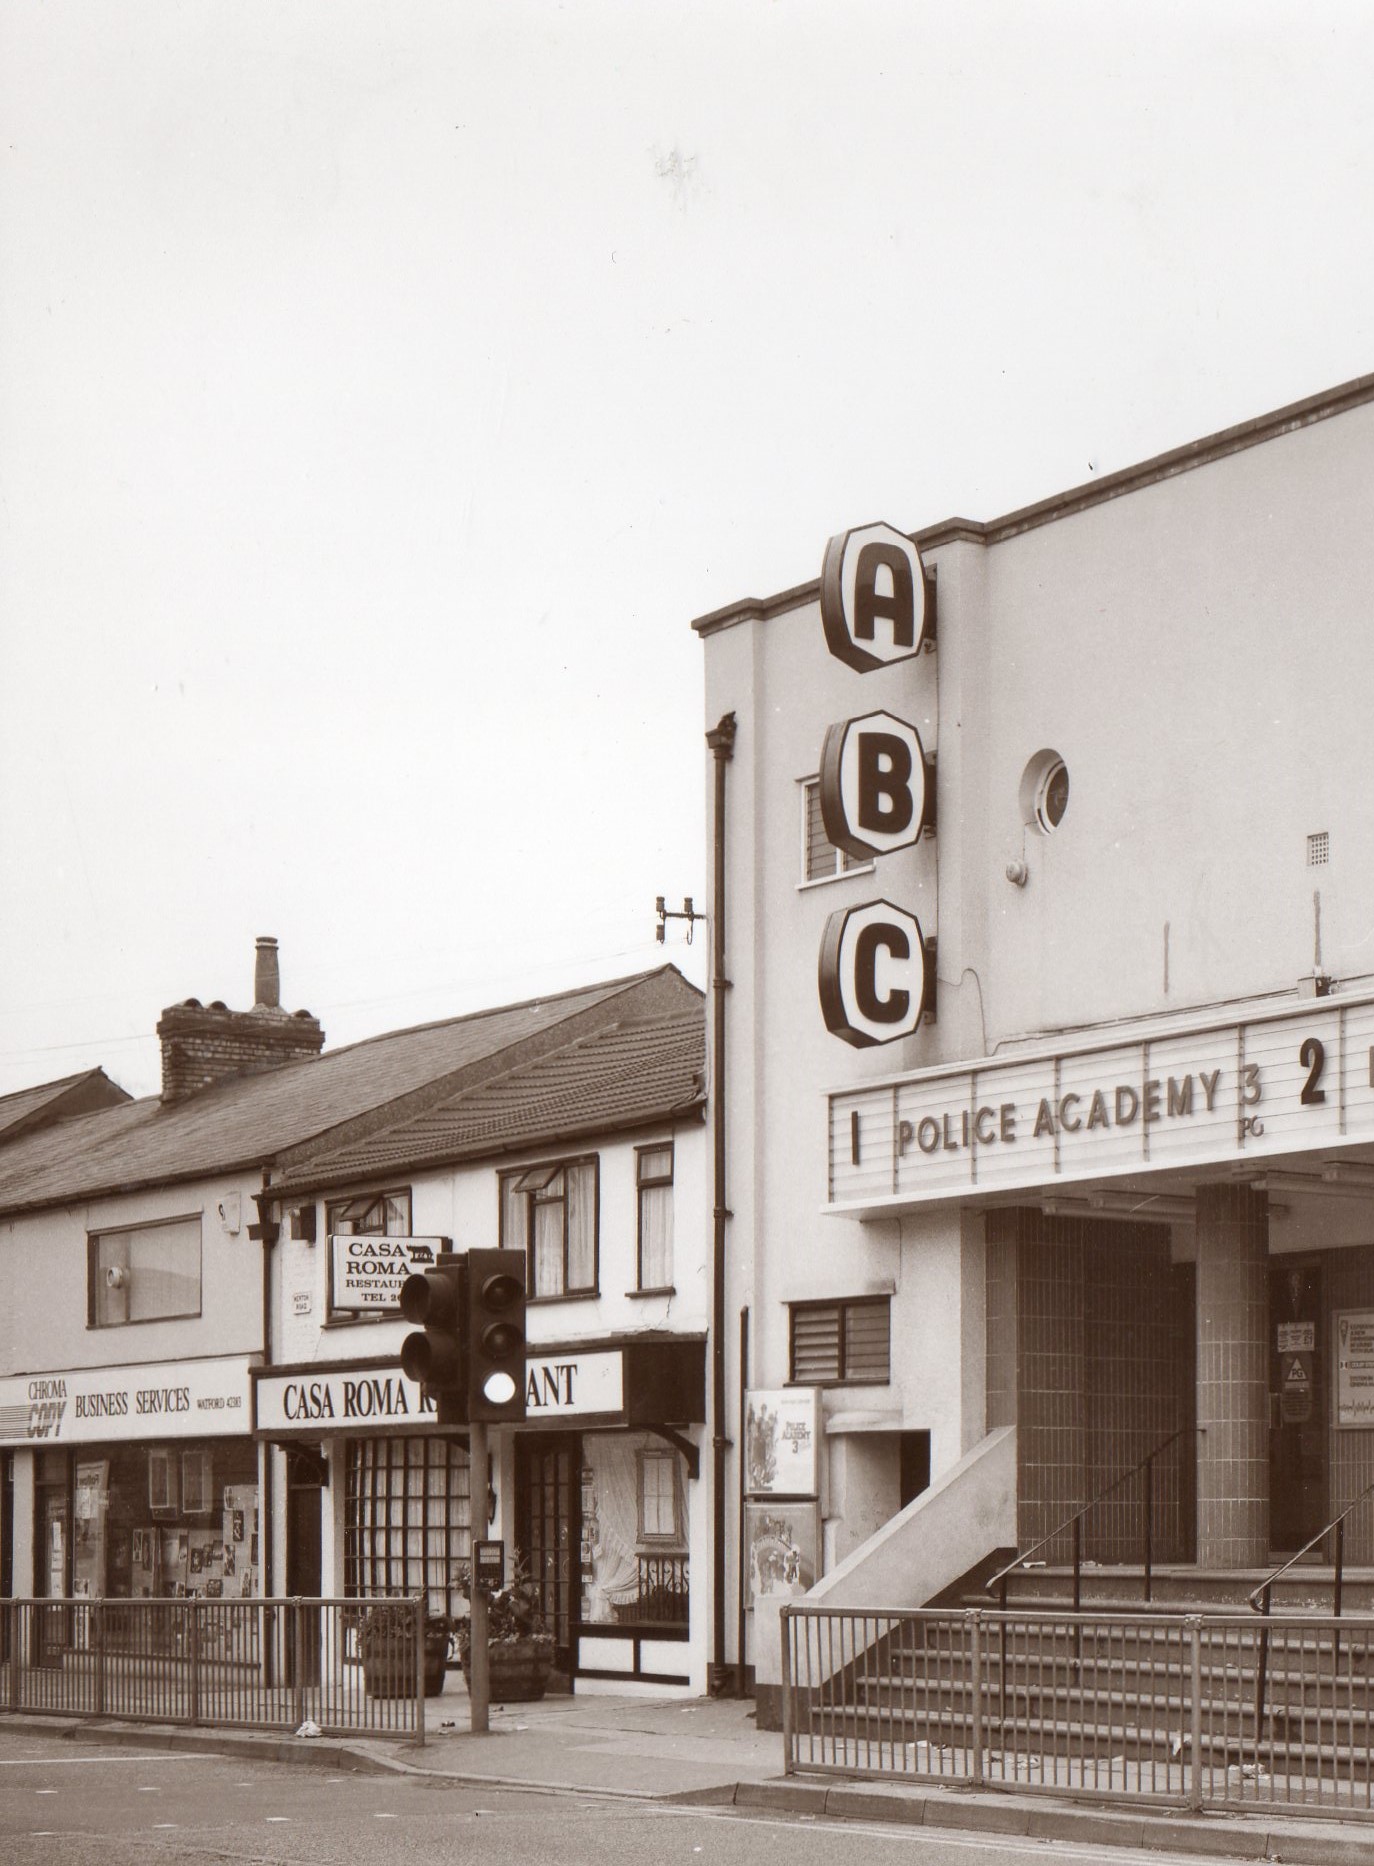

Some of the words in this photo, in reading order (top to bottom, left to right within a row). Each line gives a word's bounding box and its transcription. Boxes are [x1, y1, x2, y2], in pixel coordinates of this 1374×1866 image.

[1300, 1037, 1325, 1105] 2
[899, 1103, 1016, 1157] POLICE
[1033, 1069, 1221, 1137] ACADEMY
[1242, 1063, 1262, 1105] 3
[1241, 1115, 1265, 1140] PG
[348, 1242, 407, 1257] CASA
[345, 1260, 412, 1275] ROMA
[361, 1293, 386, 1302] TEL
[28, 1380, 67, 1400] CHROMA
[283, 1383, 335, 1419] CASA
[343, 1378, 409, 1417] ROMA
[75, 1392, 128, 1418] BUSINESS
[136, 1387, 190, 1414] SERVICES
[27, 1401, 67, 1438] COPY
[786, 1421, 806, 1431] POLICE
[782, 1430, 811, 1440] ACADEMY
[792, 1440, 799, 1454] 3
